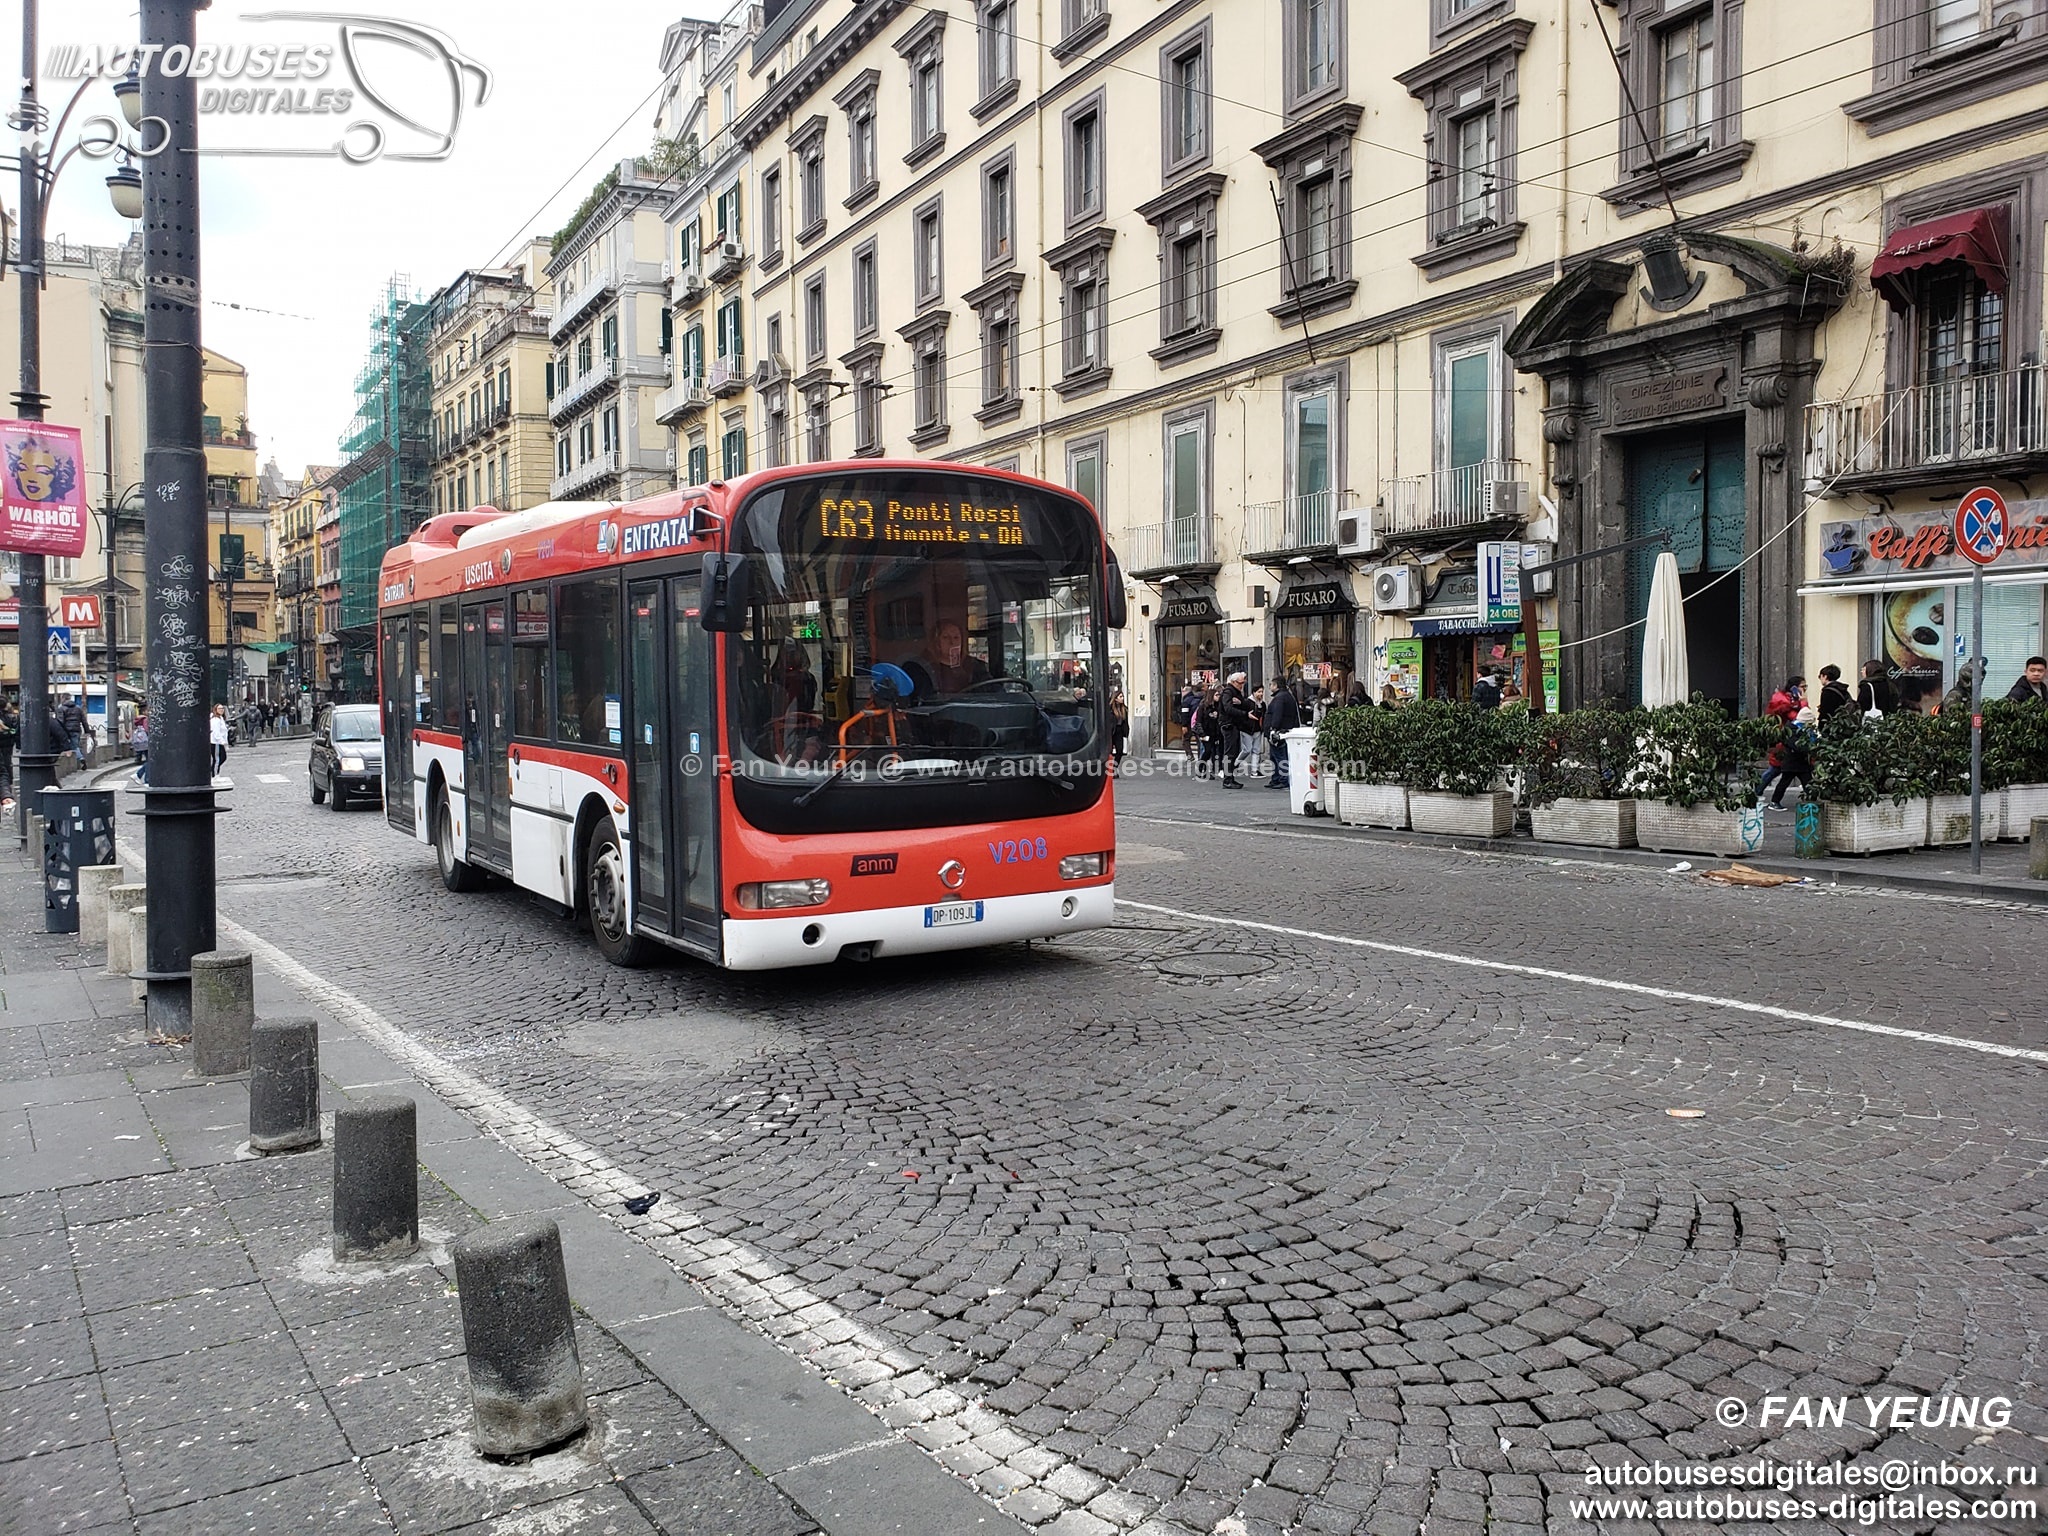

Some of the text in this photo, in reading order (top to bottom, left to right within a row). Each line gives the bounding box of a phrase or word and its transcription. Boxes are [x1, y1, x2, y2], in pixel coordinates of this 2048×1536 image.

[1631, 375, 1704, 400] DIREZIONE
[8, 505, 81, 528] WARHOL
[821, 499, 1021, 539] C63 Ponti Rossi
[624, 517, 689, 554] ENTRATA
[465, 560, 495, 585] USCITA
[384, 582, 405, 603] ENTRATA
[1289, 589, 1337, 607] FUSARO
[68, 602, 95, 622] M
[1168, 601, 1208, 618] FUSARO
[1489, 609, 1500, 619] 24
[1501, 609, 1519, 618] ORE
[1437, 616, 1493, 631] TABACCHE
[988, 837, 1048, 864] V208
[857, 857, 894, 872] anm
